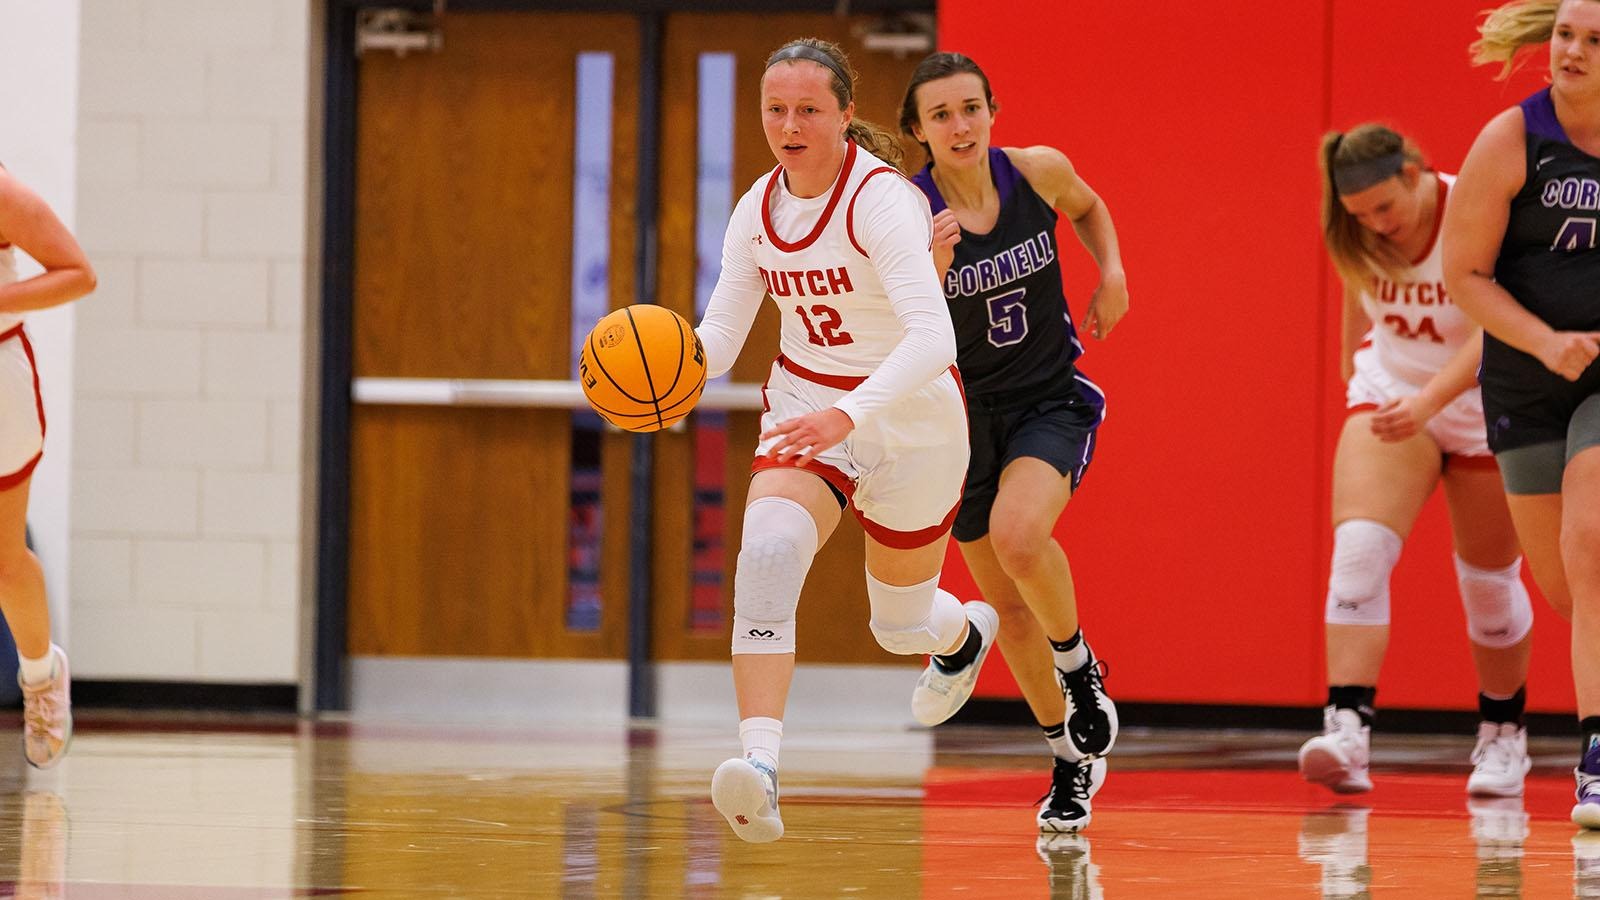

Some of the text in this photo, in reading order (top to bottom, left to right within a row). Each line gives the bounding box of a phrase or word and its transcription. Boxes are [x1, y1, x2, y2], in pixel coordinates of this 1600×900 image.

[758, 266, 854, 297] DUTCH
[943, 230, 1055, 299] CORNELL
[795, 304, 854, 347] 12
[986, 287, 1029, 348] 5
